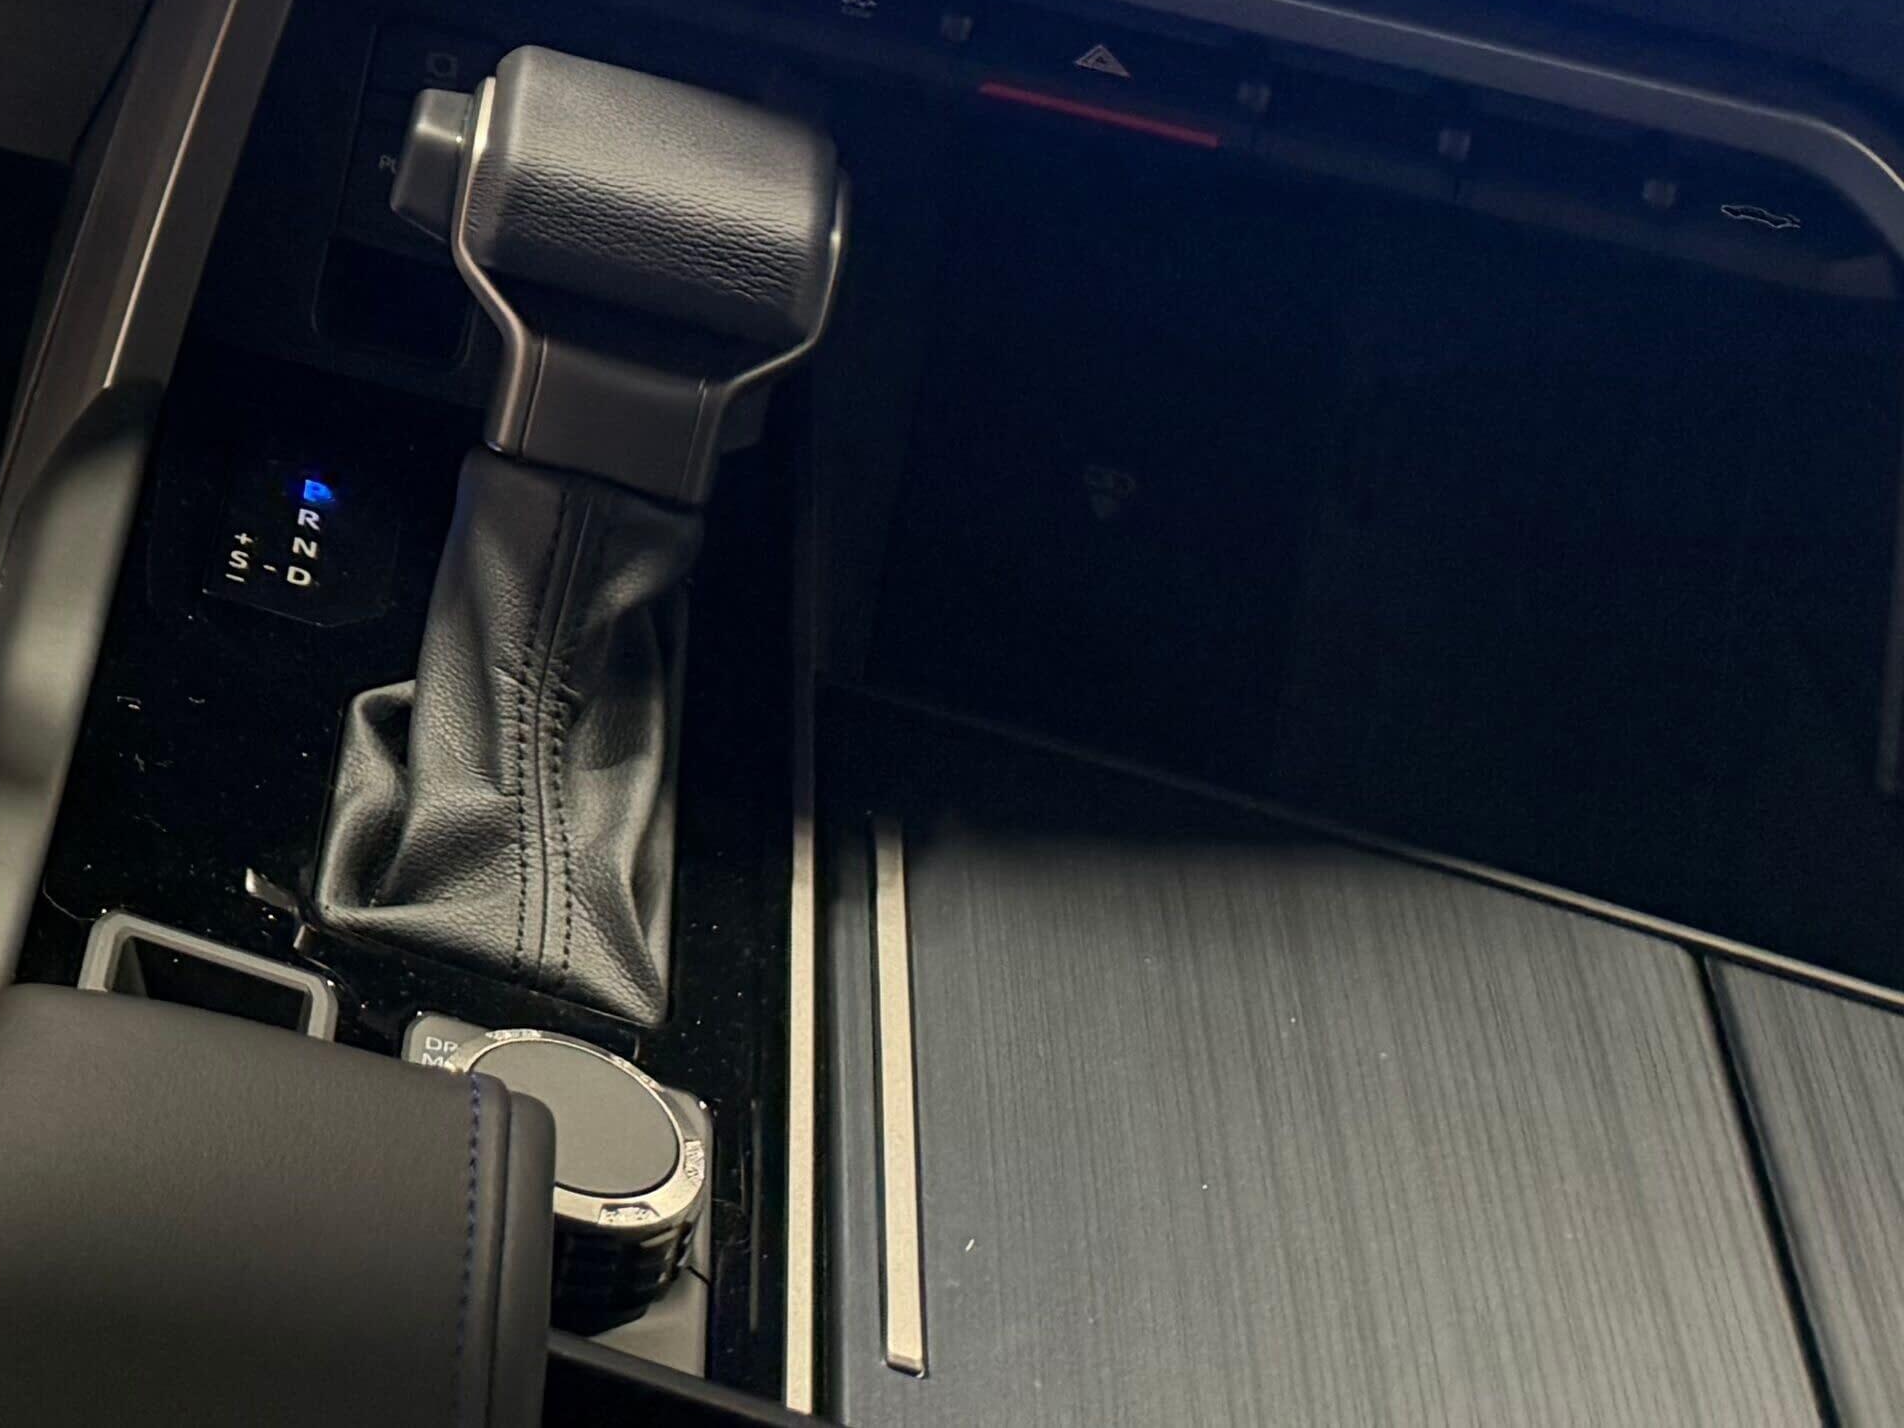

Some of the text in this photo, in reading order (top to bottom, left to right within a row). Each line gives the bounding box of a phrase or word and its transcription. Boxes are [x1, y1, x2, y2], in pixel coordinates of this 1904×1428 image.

[296, 507, 321, 531] R
[291, 535, 319, 561] N
[285, 564, 313, 588] D
